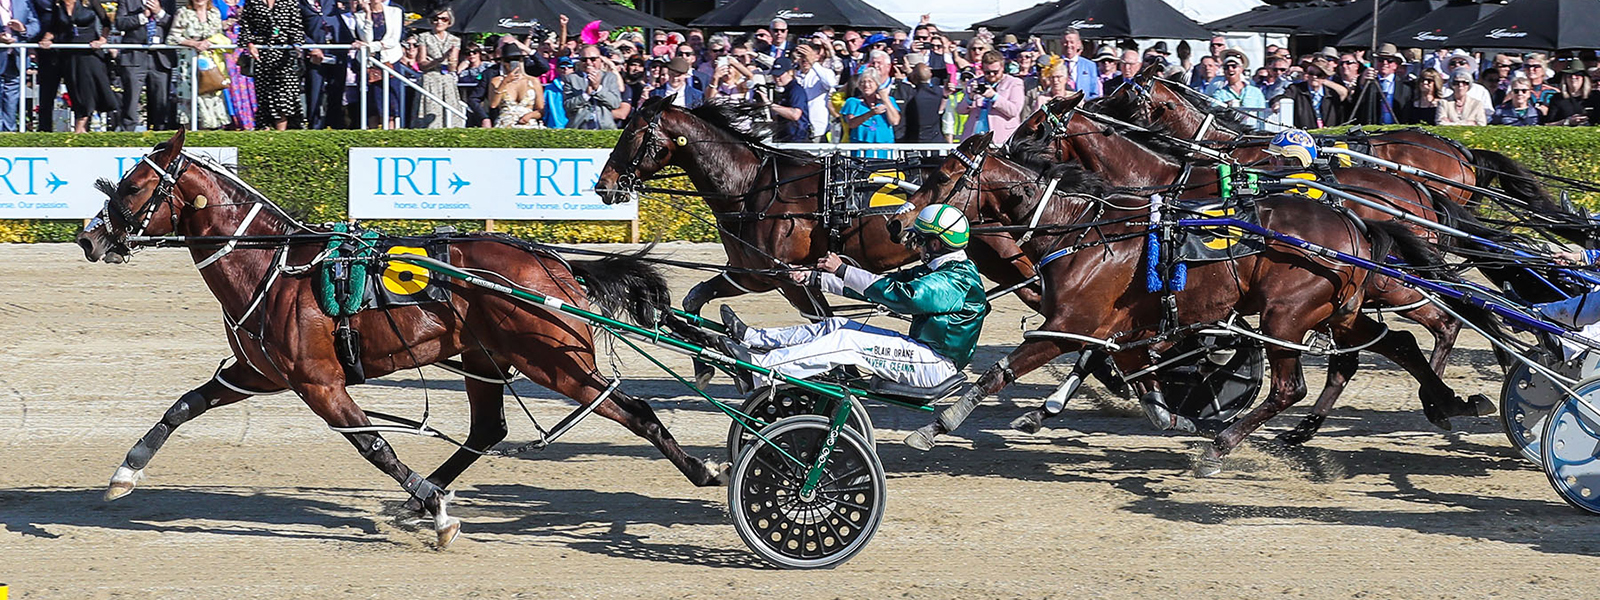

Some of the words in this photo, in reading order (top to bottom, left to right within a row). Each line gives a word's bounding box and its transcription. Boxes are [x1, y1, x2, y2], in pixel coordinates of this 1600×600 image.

[0, 157, 49, 195] RT
[373, 157, 452, 196] IRT
[515, 157, 594, 196] IRT
[17, 201, 34, 209] Our
[35, 202, 70, 210] passion.
[394, 201, 419, 209] horse.
[420, 201, 437, 209] Our
[438, 201, 471, 210] passion.
[515, 202, 535, 210] Your
[536, 202, 560, 210] horse.
[562, 202, 579, 210] Our
[873, 345, 891, 356] BLAIR
